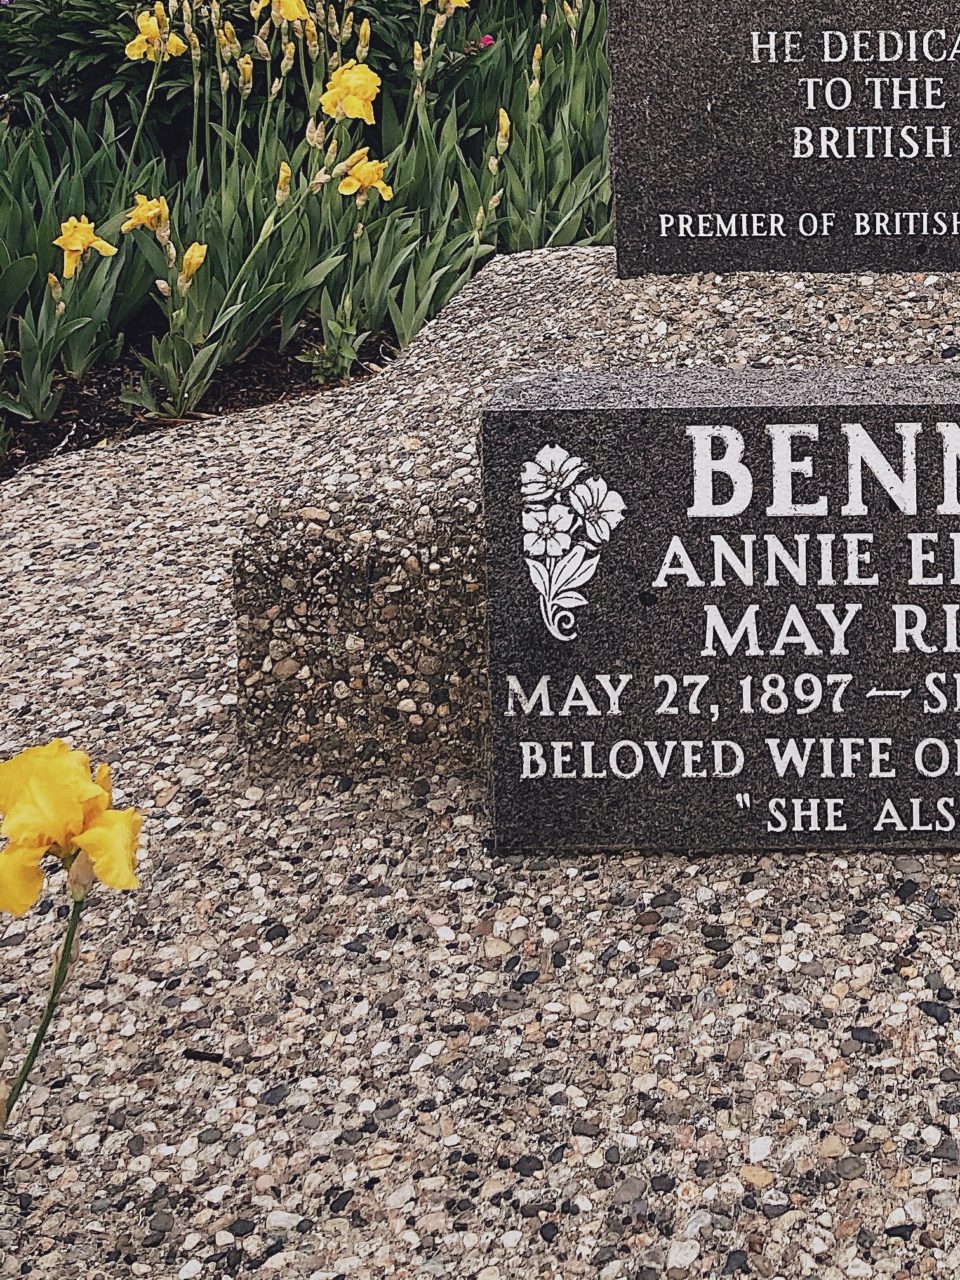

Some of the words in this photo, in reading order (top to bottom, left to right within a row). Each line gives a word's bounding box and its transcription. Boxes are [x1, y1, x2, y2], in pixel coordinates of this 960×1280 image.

[751, 31, 805, 63] HE
[798, 77, 852, 110] TO
[865, 77, 946, 109] THE
[793, 126, 950, 159] BRITISH
[660, 214, 784, 237] PREMIER
[798, 213, 833, 236] OF
[652, 534, 879, 588] ANNIE
[701, 603, 862, 657] MAY
[506, 674, 633, 716] MAY
[653, 675, 719, 722] 27,
[740, 674, 852, 714] 1897
[520, 740, 745, 779] BELOVED
[766, 738, 896, 778] WIFE
